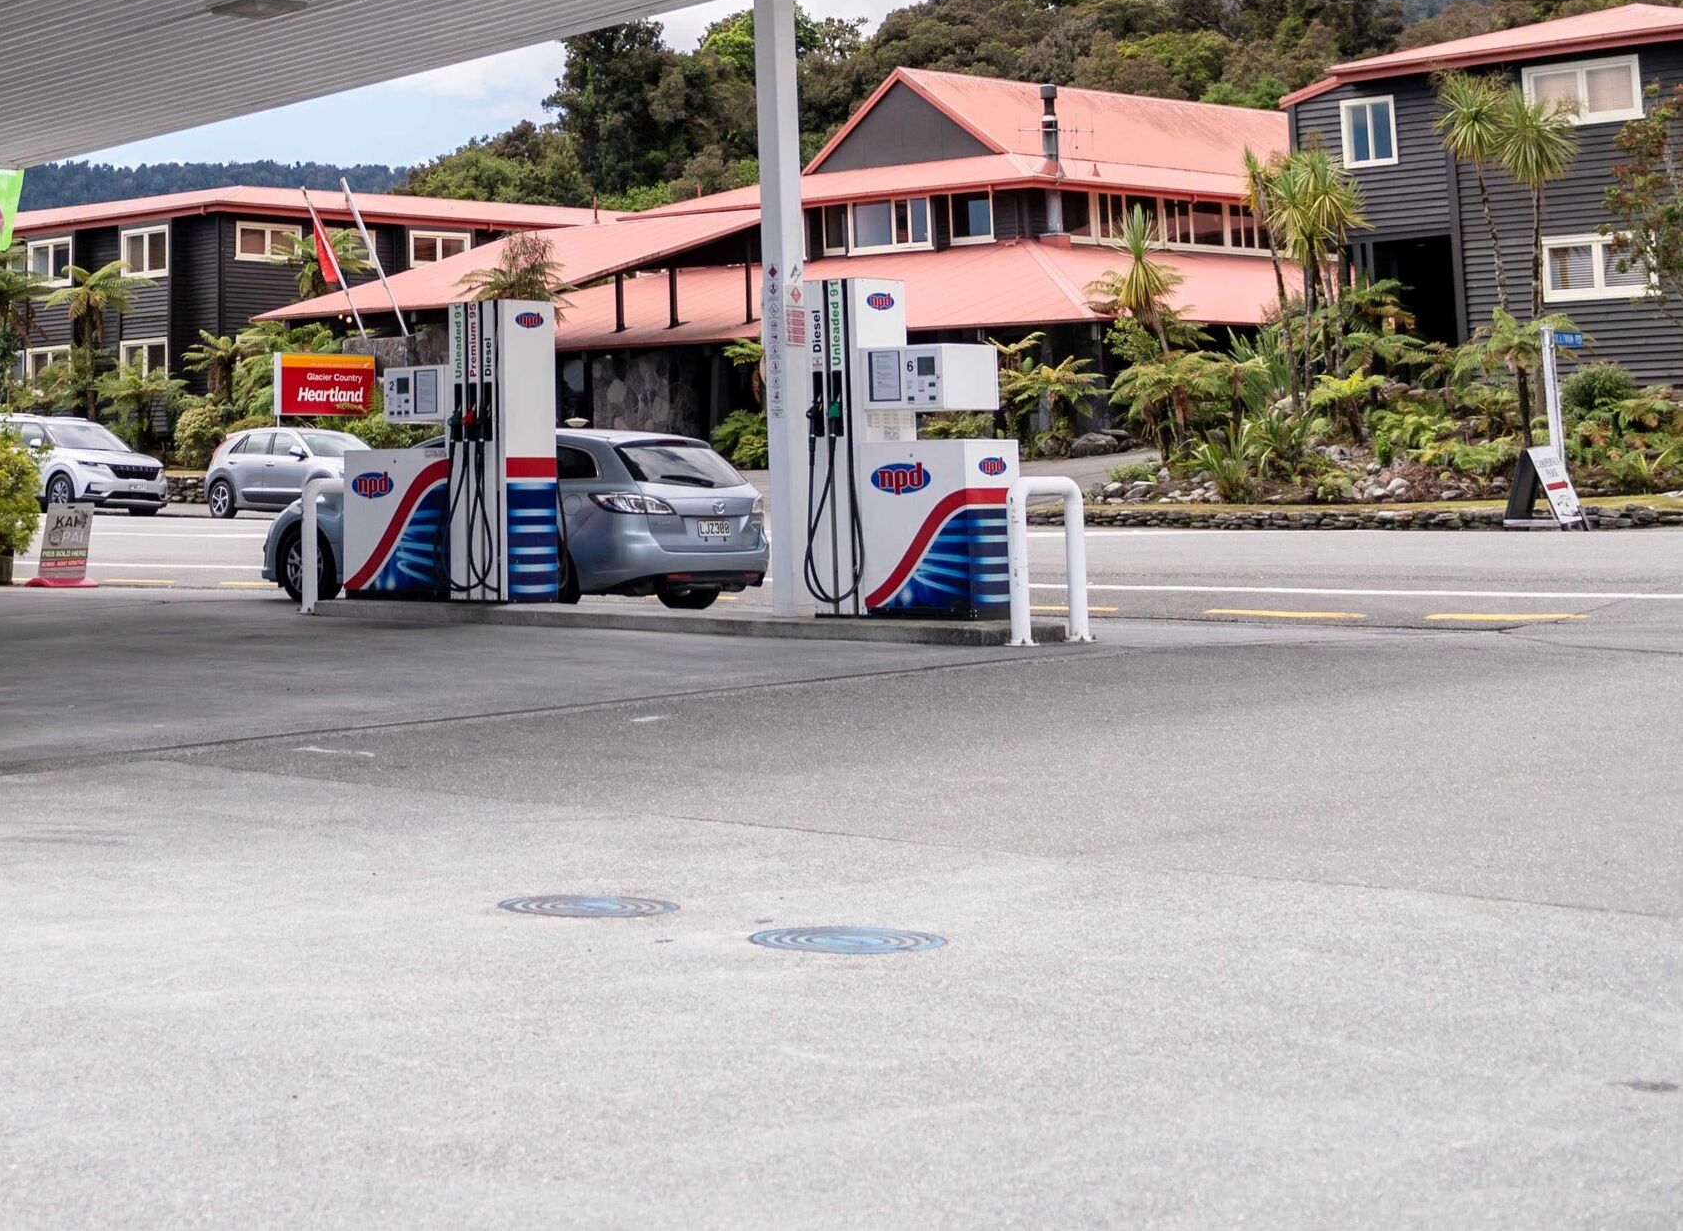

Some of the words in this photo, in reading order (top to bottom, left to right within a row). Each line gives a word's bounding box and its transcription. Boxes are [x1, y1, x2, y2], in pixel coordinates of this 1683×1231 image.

[829, 280, 839, 297] 91
[871, 293, 891, 311] npd
[455, 303, 462, 319] 91
[469, 303, 476, 319] 95
[518, 312, 540, 329] npd
[811, 309, 822, 353] Diesel
[830, 301, 841, 366] Unleaded
[469, 321, 477, 377] Premium
[484, 337, 492, 377] Diesel
[906, 360, 914, 372] 6
[306, 372, 332, 381] Glacier
[333, 373, 363, 385] Country
[389, 381, 395, 391] 2
[297, 386, 364, 402] Heartland
[982, 457, 1004, 476] npd
[357, 471, 389, 499] npd
[878, 462, 924, 495] npd
